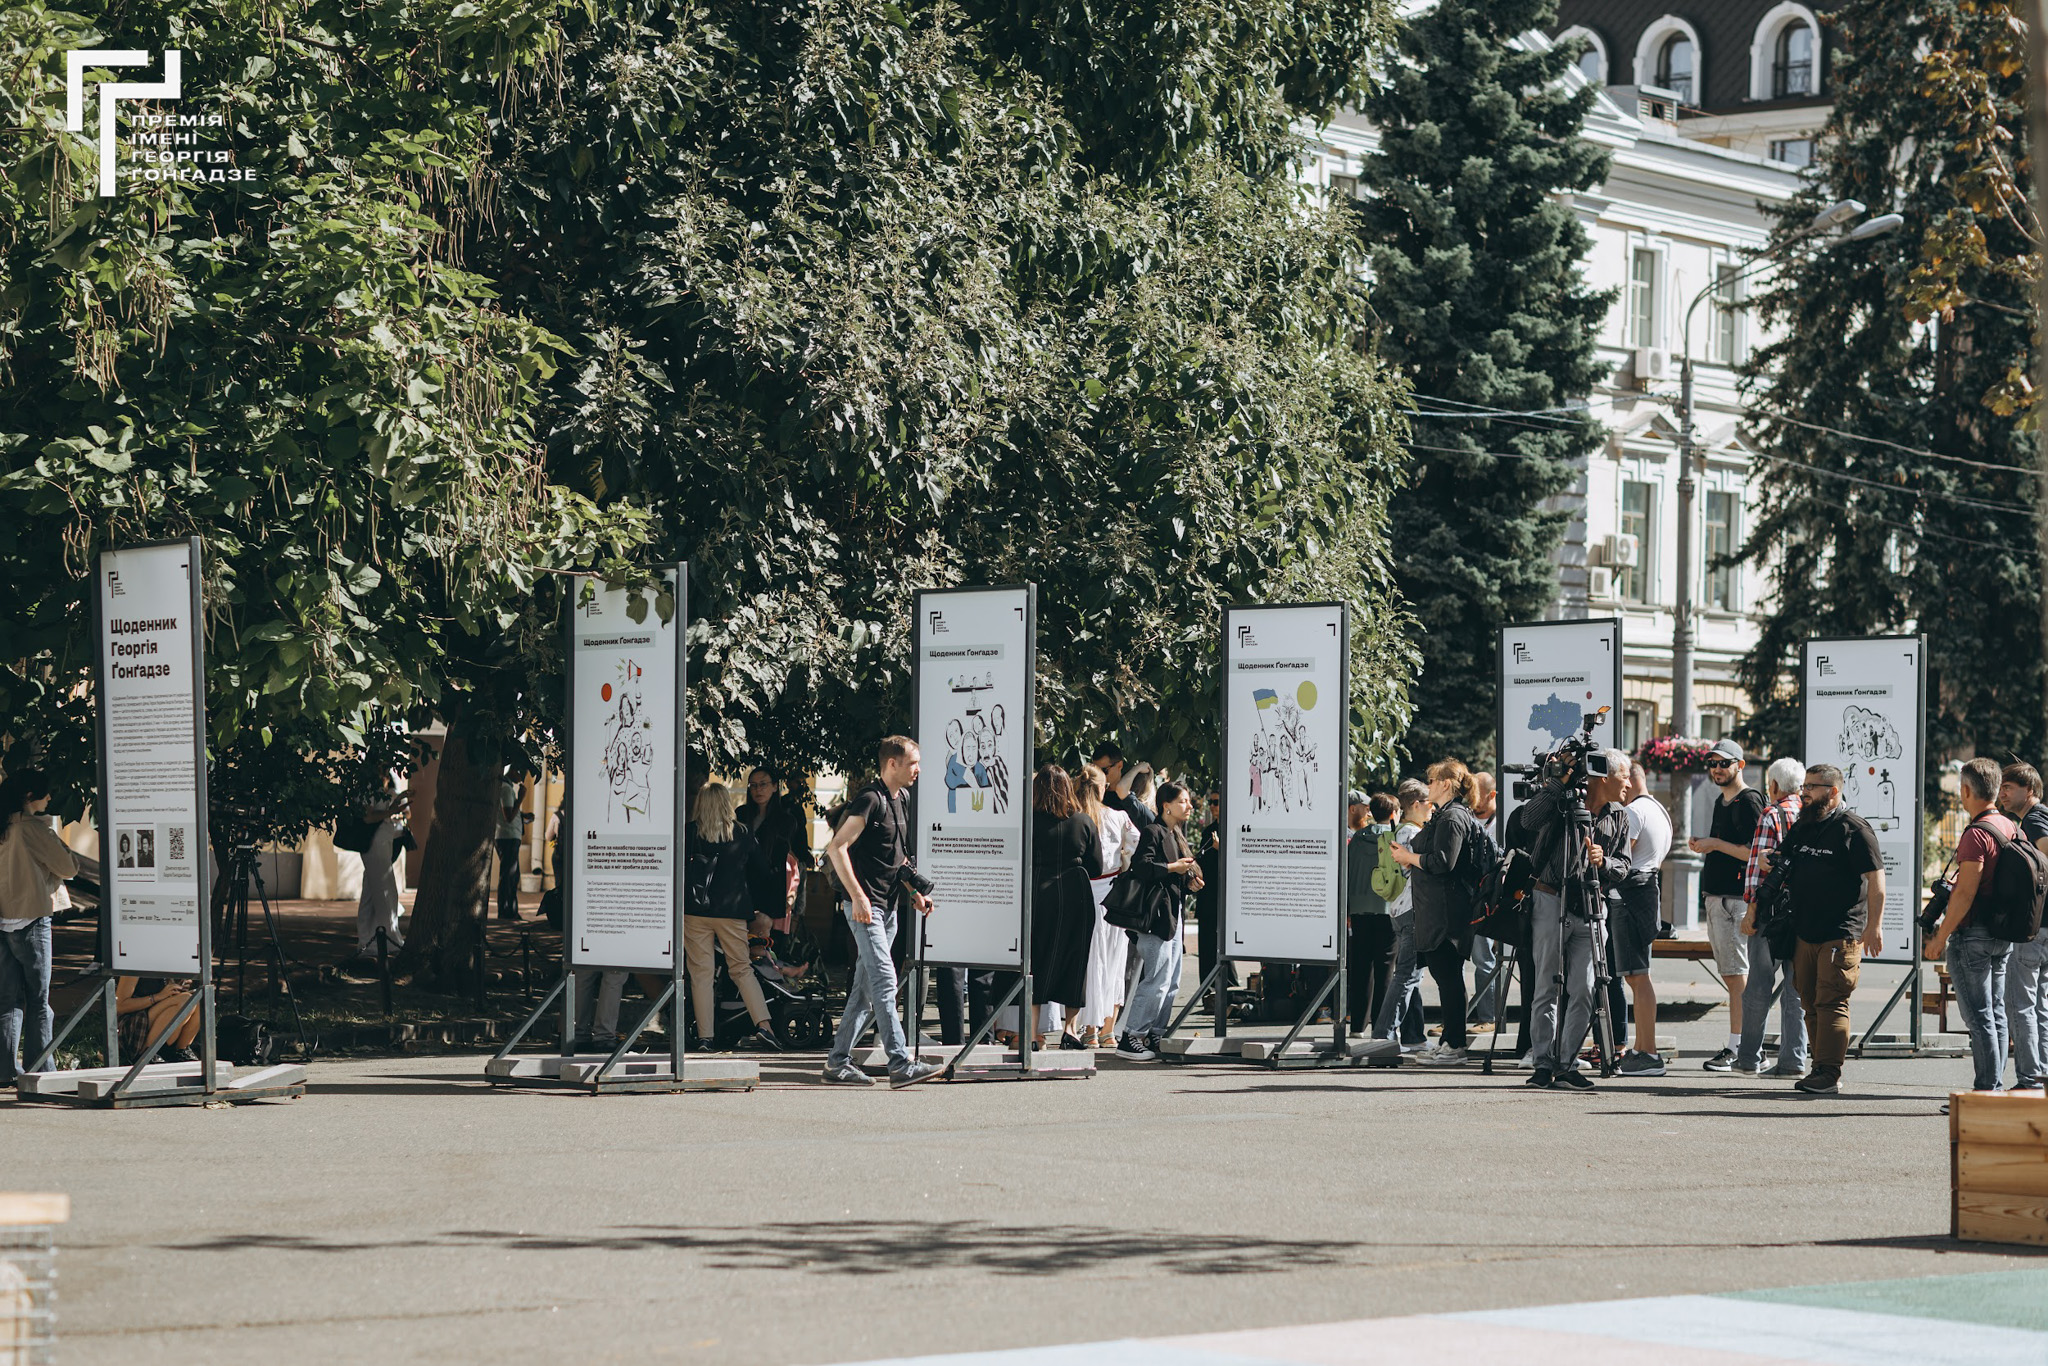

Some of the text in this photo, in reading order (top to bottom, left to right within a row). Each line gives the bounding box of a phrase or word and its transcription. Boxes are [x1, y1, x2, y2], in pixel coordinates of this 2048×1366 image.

[110, 618, 178, 636] Щоденник
[583, 638, 619, 647] Щоденник
[111, 639, 158, 659] Георгія
[929, 650, 966, 658] Щоденник
[1237, 662, 1275, 670] Щоденник
[112, 661, 171, 680] Ґонґадзе
[1513, 677, 1551, 685] Щоденник
[1816, 689, 1853, 697] Щоденник
